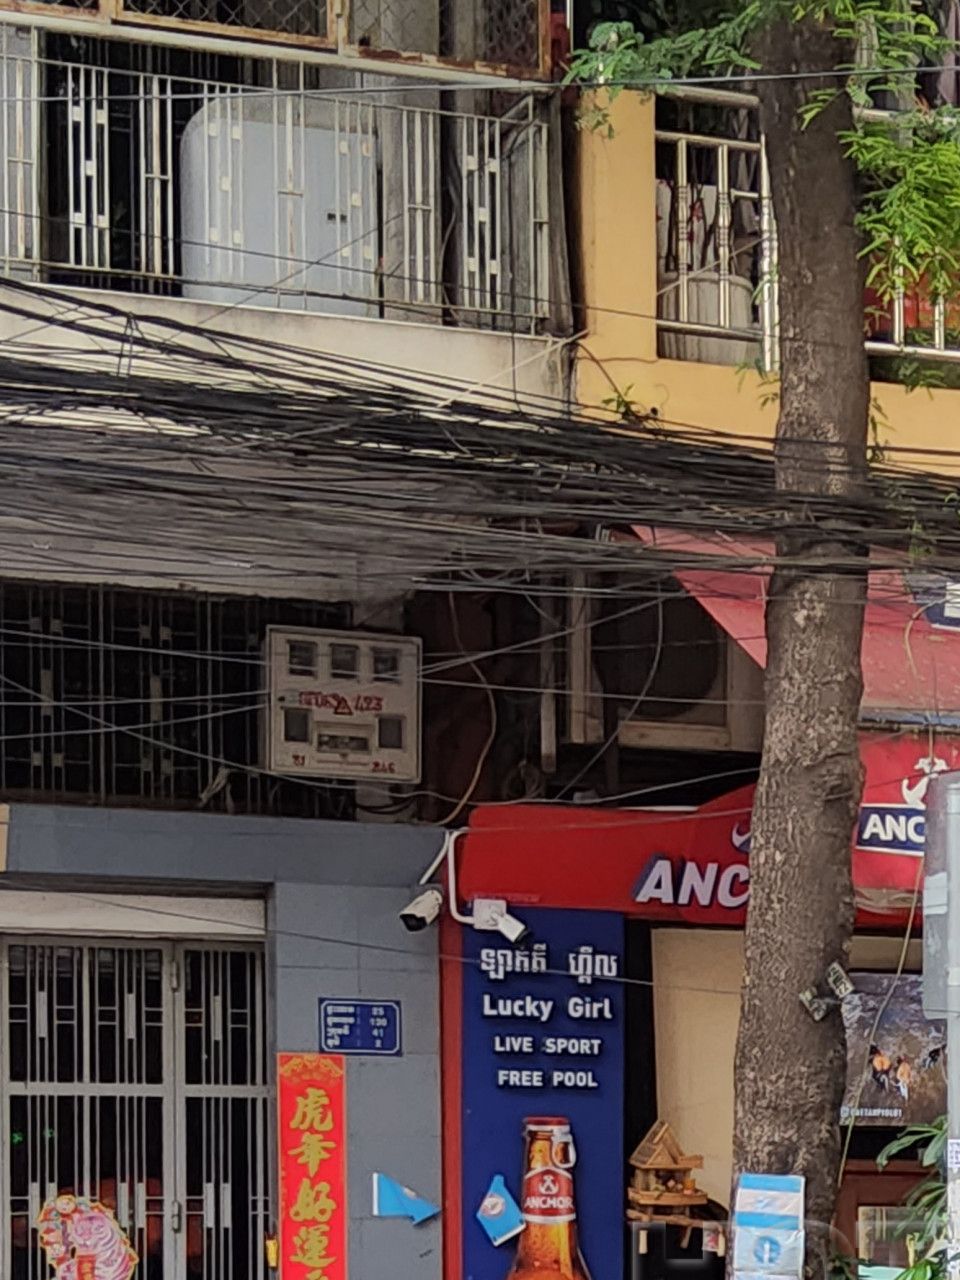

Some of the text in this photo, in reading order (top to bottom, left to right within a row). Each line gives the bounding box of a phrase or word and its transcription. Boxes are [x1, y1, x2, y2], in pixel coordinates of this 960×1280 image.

[863, 813, 925, 843] ANC
[635, 859, 750, 908] ANC
[482, 994, 613, 1022] Lucky Girl
[494, 1036, 602, 1055] LIVE SPORT
[497, 1070, 599, 1088] FREE POOL
[524, 1196, 575, 1209] ANCHOR
